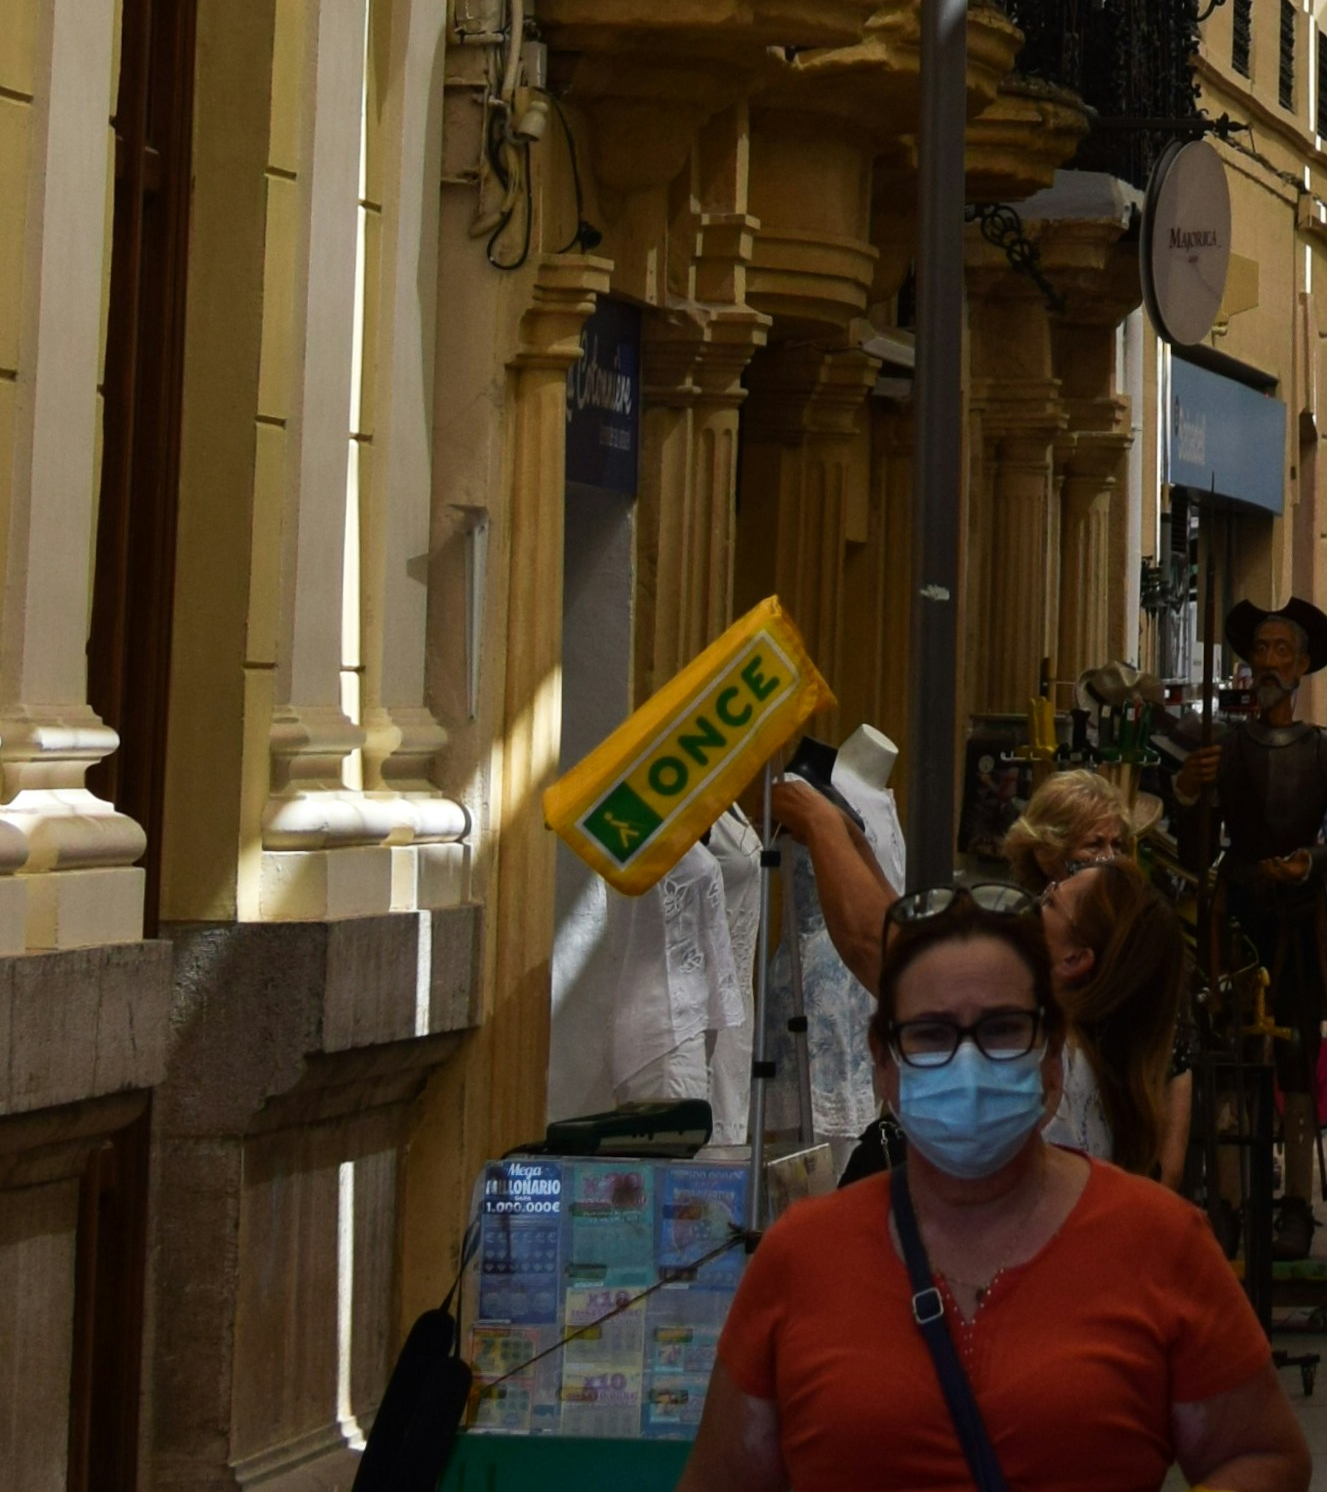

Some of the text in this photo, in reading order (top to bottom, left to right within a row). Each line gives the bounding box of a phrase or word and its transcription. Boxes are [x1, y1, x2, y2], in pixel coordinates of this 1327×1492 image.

[648, 655, 781, 796] ONCE
[507, 1162, 543, 1177] Mega
[485, 1201, 561, 1213] 1.000.000€
